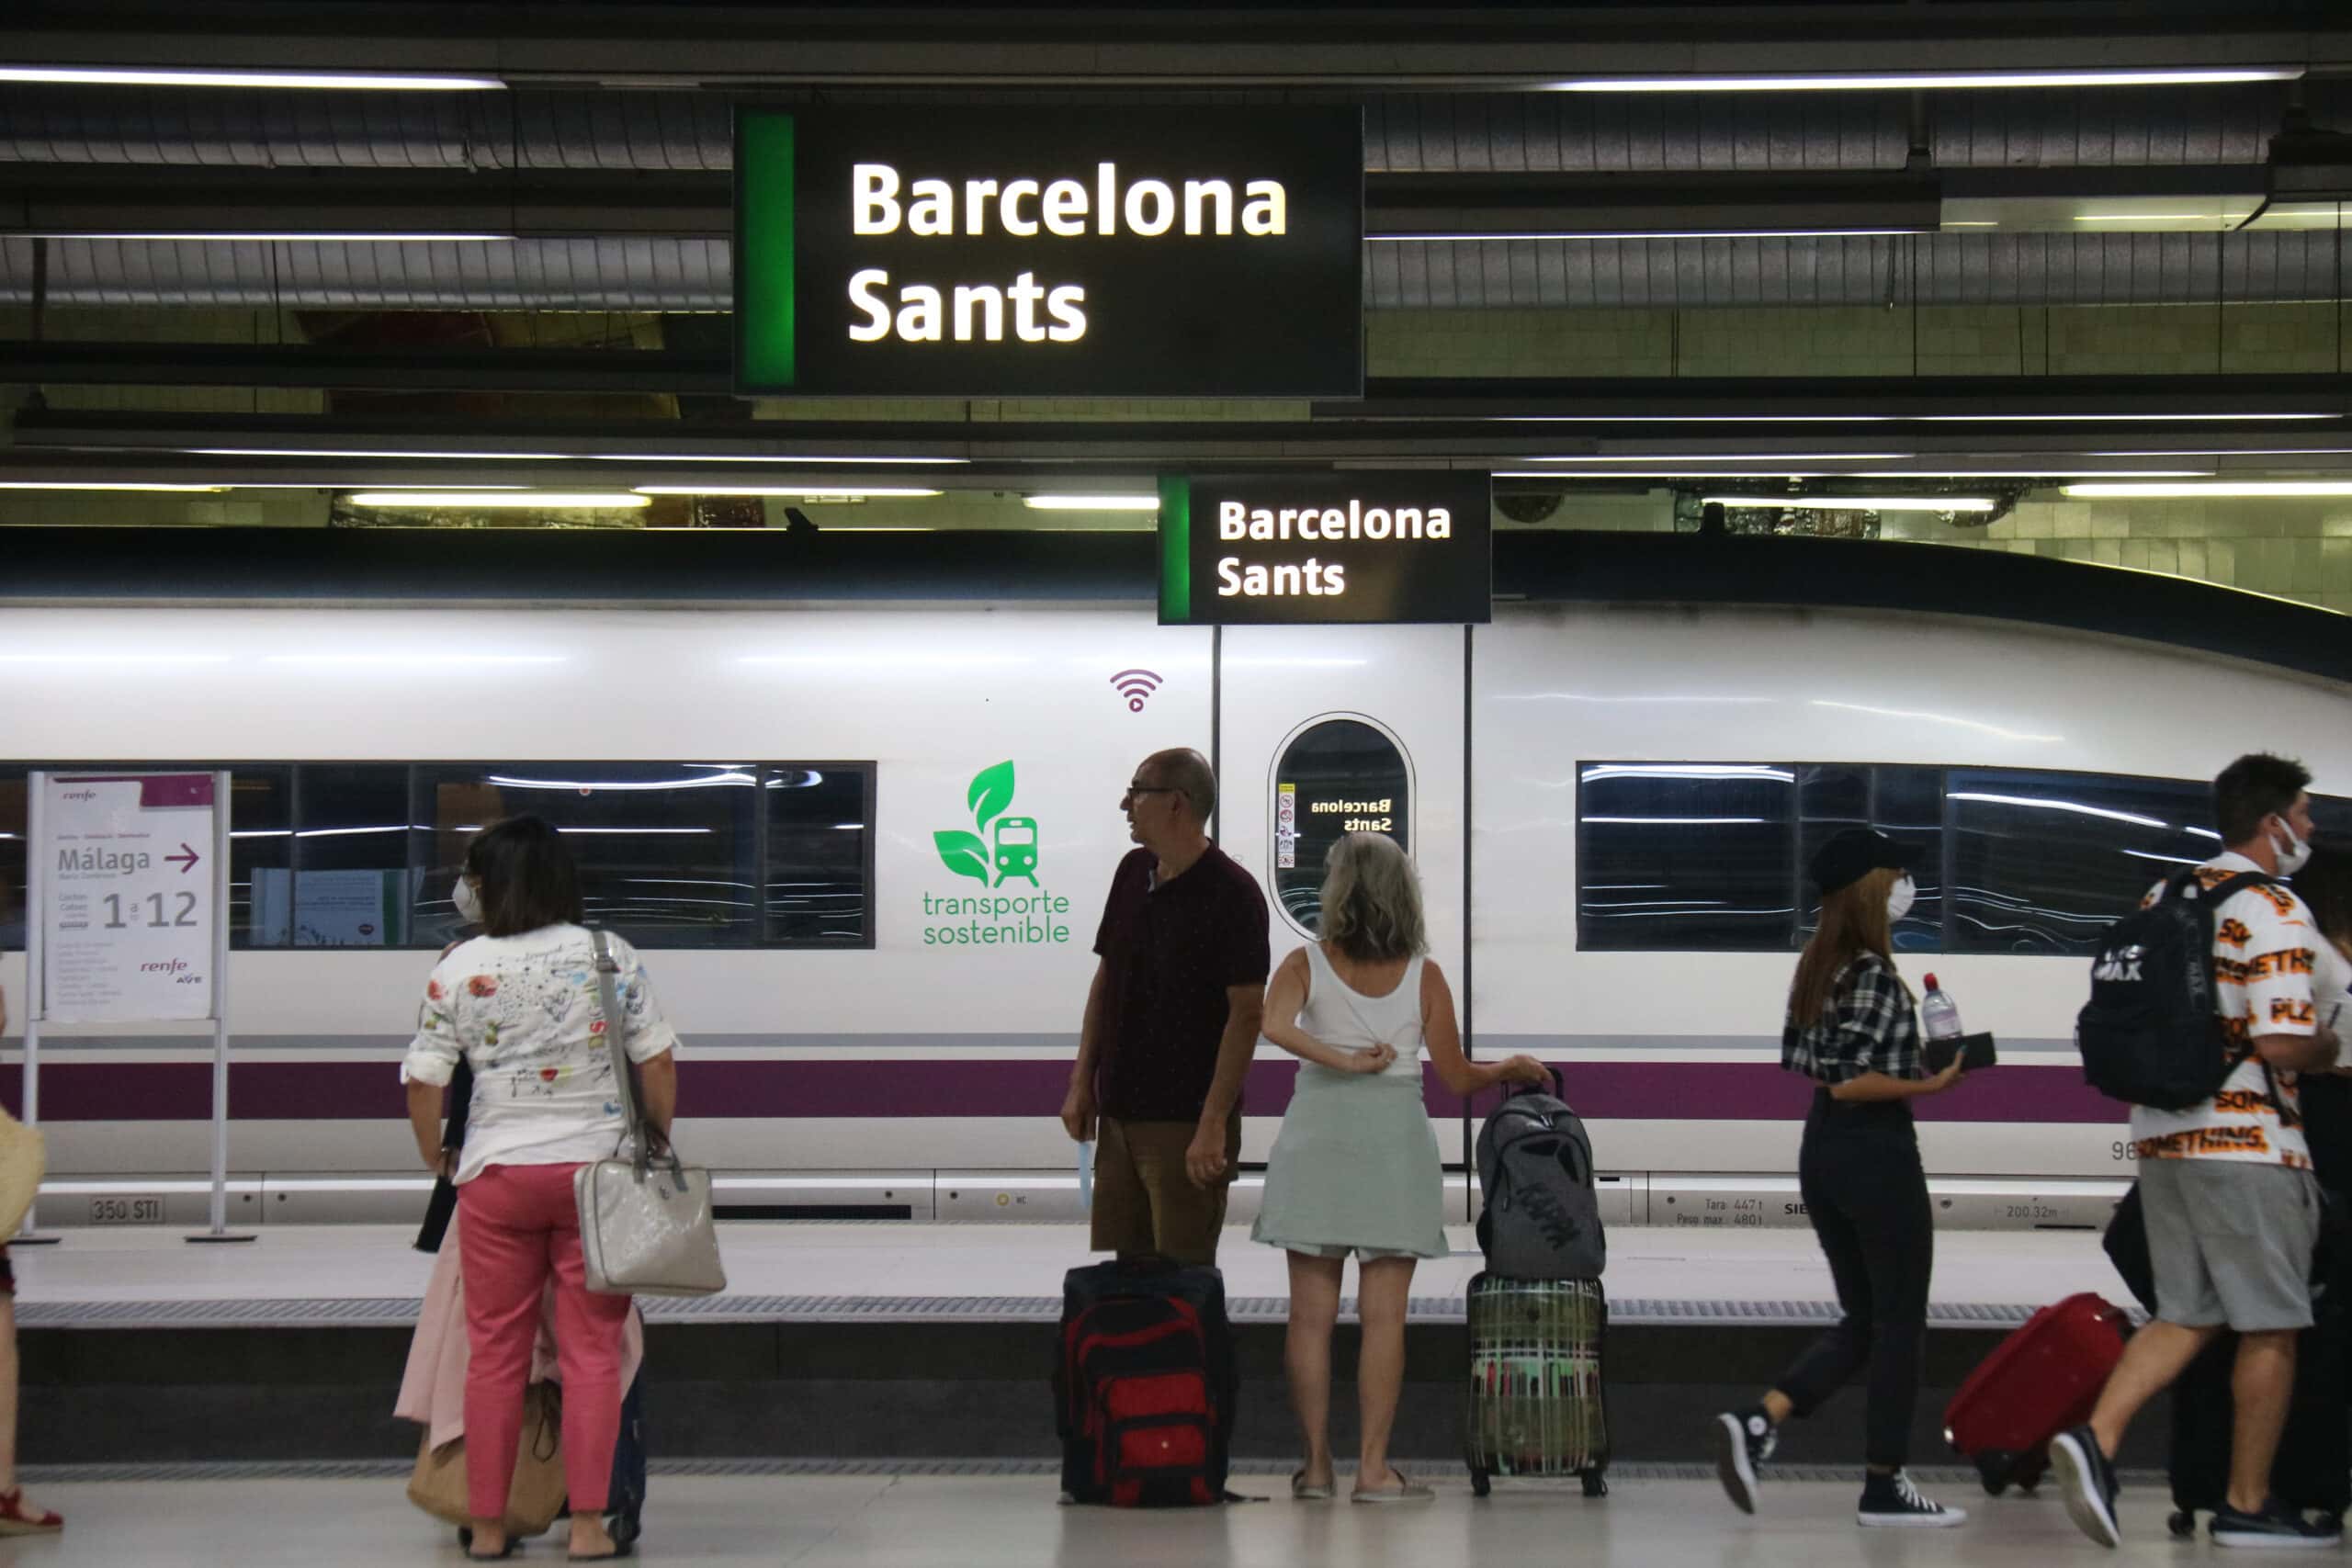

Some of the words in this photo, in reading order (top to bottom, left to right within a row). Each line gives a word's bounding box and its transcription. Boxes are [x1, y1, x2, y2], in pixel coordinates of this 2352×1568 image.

[852, 162, 1287, 237] Barcelona
[847, 269, 1088, 343] Sants
[1219, 499, 1452, 540] Barcelona
[1217, 557, 1345, 596] Sants
[62, 789, 96, 802] renfe
[58, 847, 151, 874] Málaga
[103, 893, 127, 929] 1
[146, 891, 198, 928] 12
[922, 889, 1070, 921] transporte
[922, 915, 1070, 945] sostenible
[140, 958, 188, 976] renfe
[94, 1200, 127, 1220] 350
[133, 1200, 160, 1220] STI
[1784, 1203, 1810, 1215] SIE
